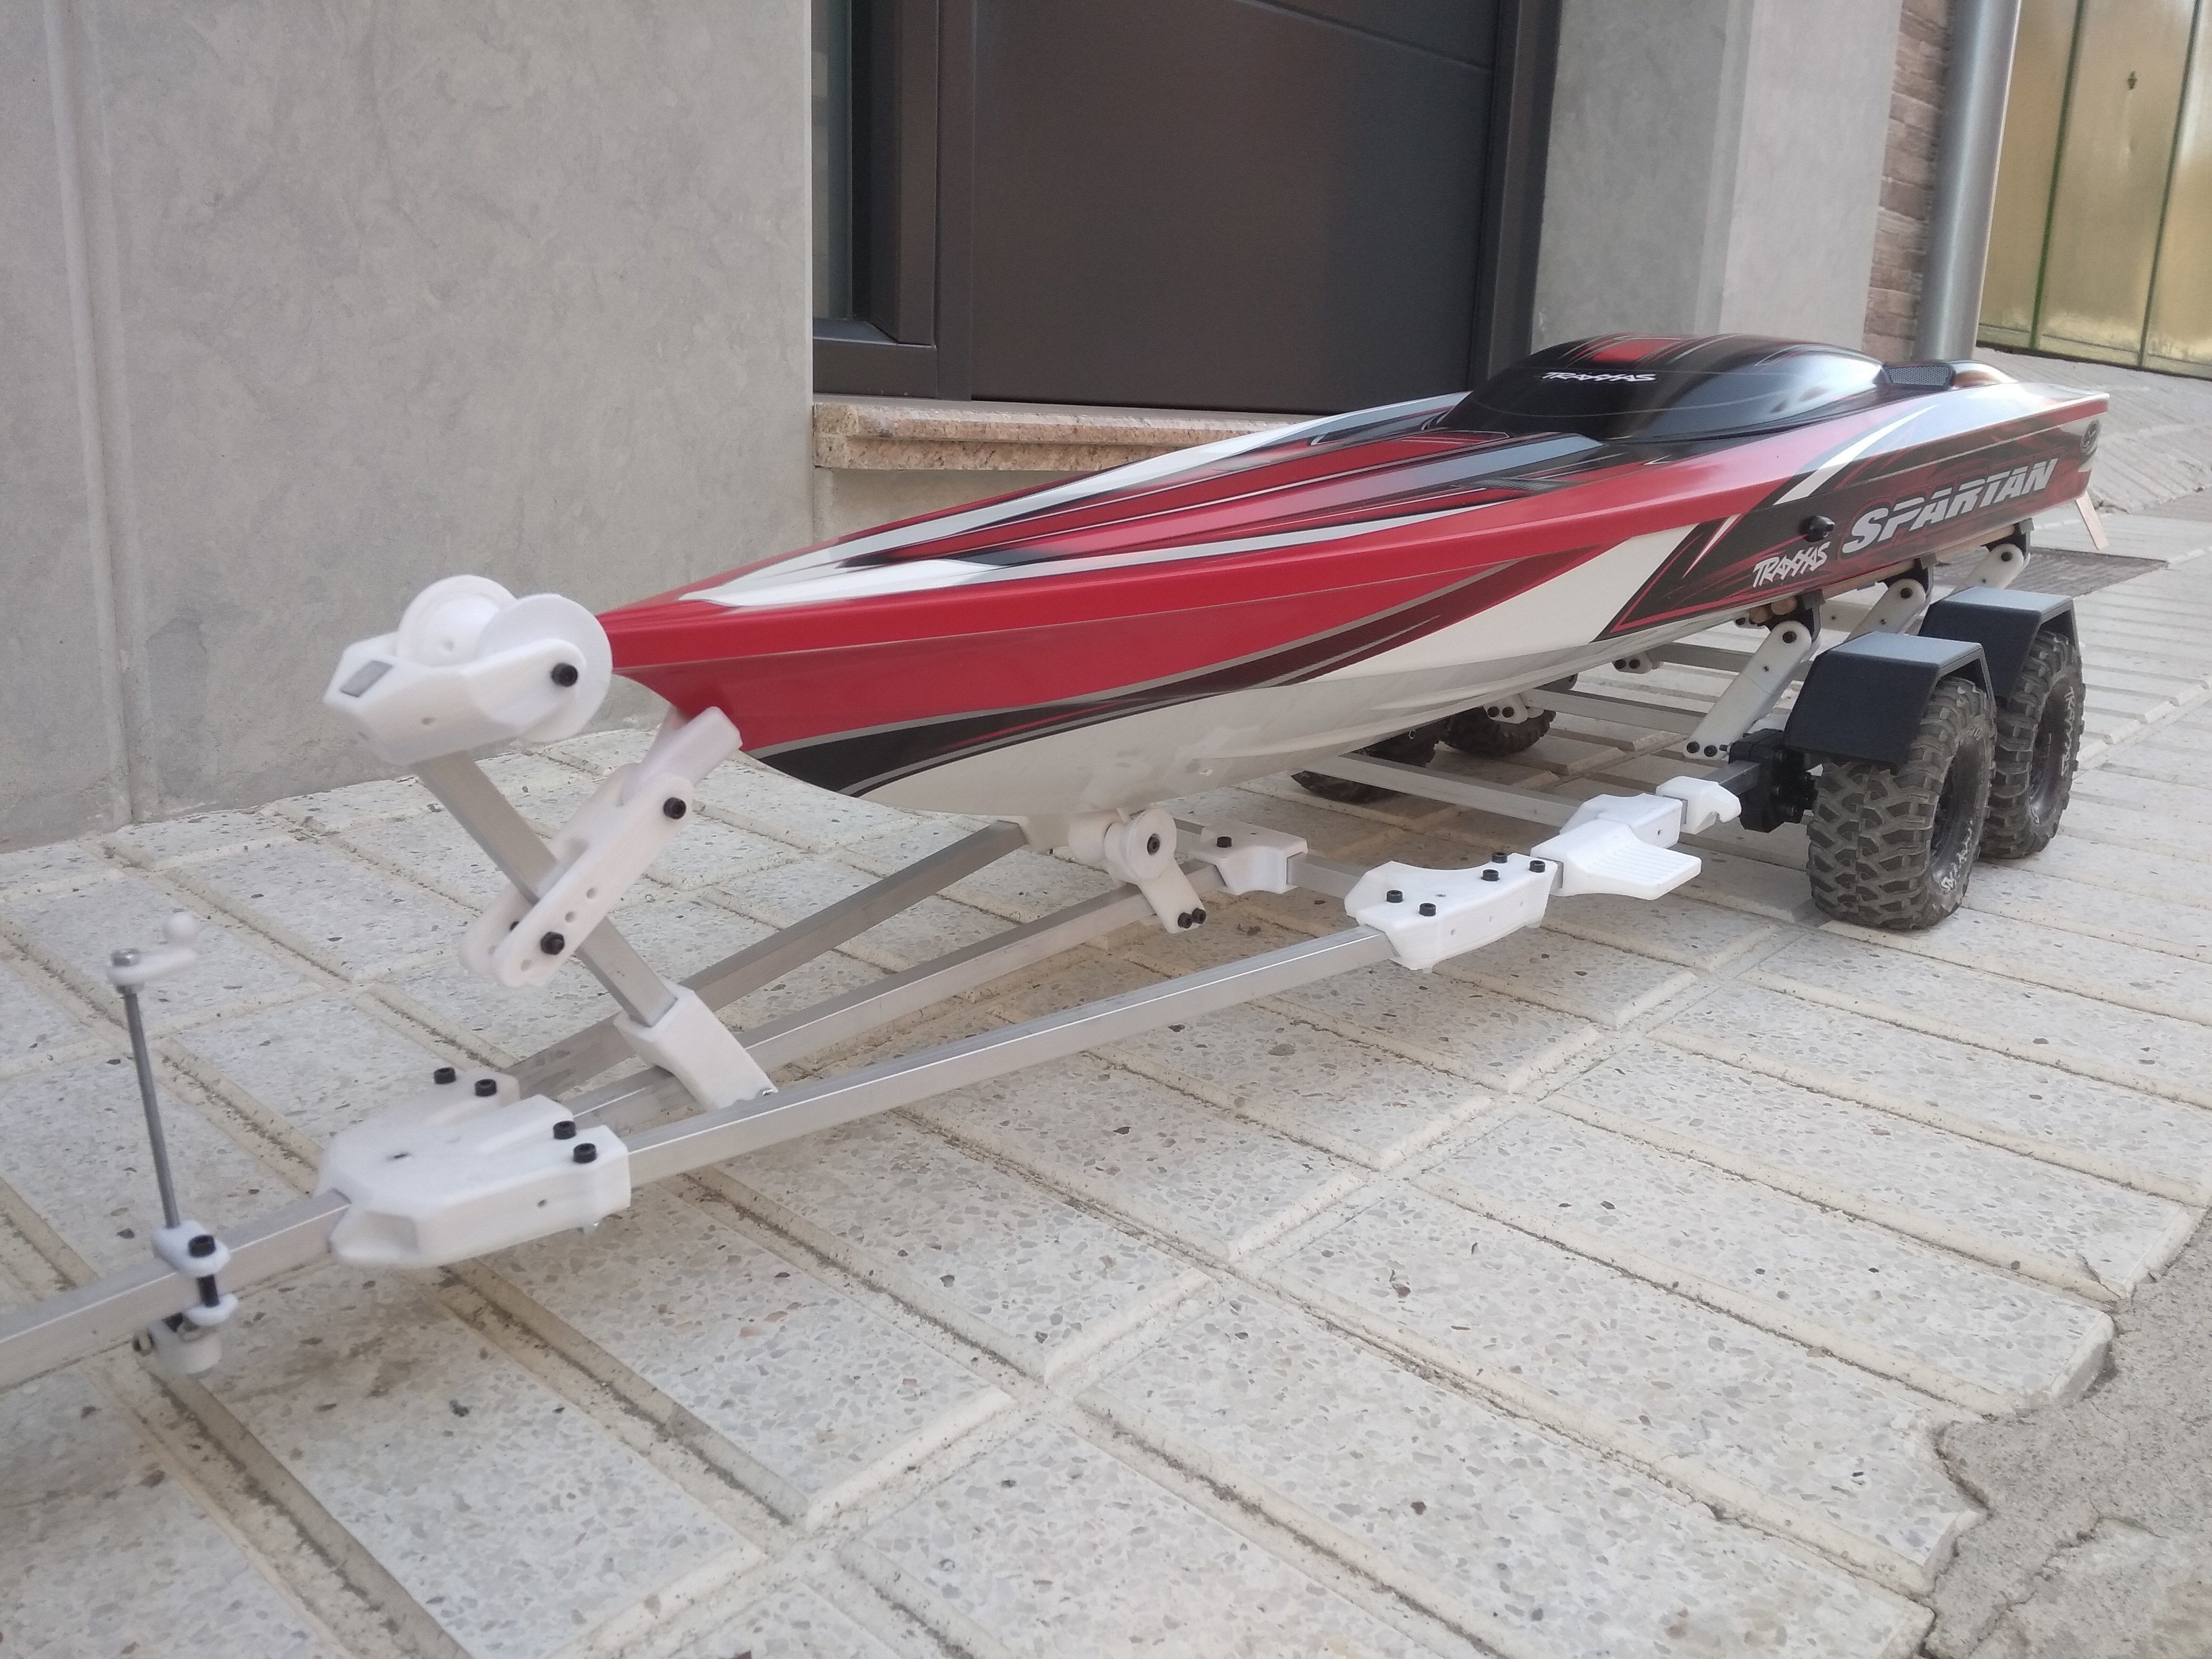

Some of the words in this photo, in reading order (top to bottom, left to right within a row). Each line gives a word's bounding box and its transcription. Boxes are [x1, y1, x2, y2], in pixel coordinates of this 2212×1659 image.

[1543, 372, 1656, 382] TRAXXAS
[1842, 458, 2058, 554] SPARTAN
[1753, 541, 1831, 588] TRAXXAS
